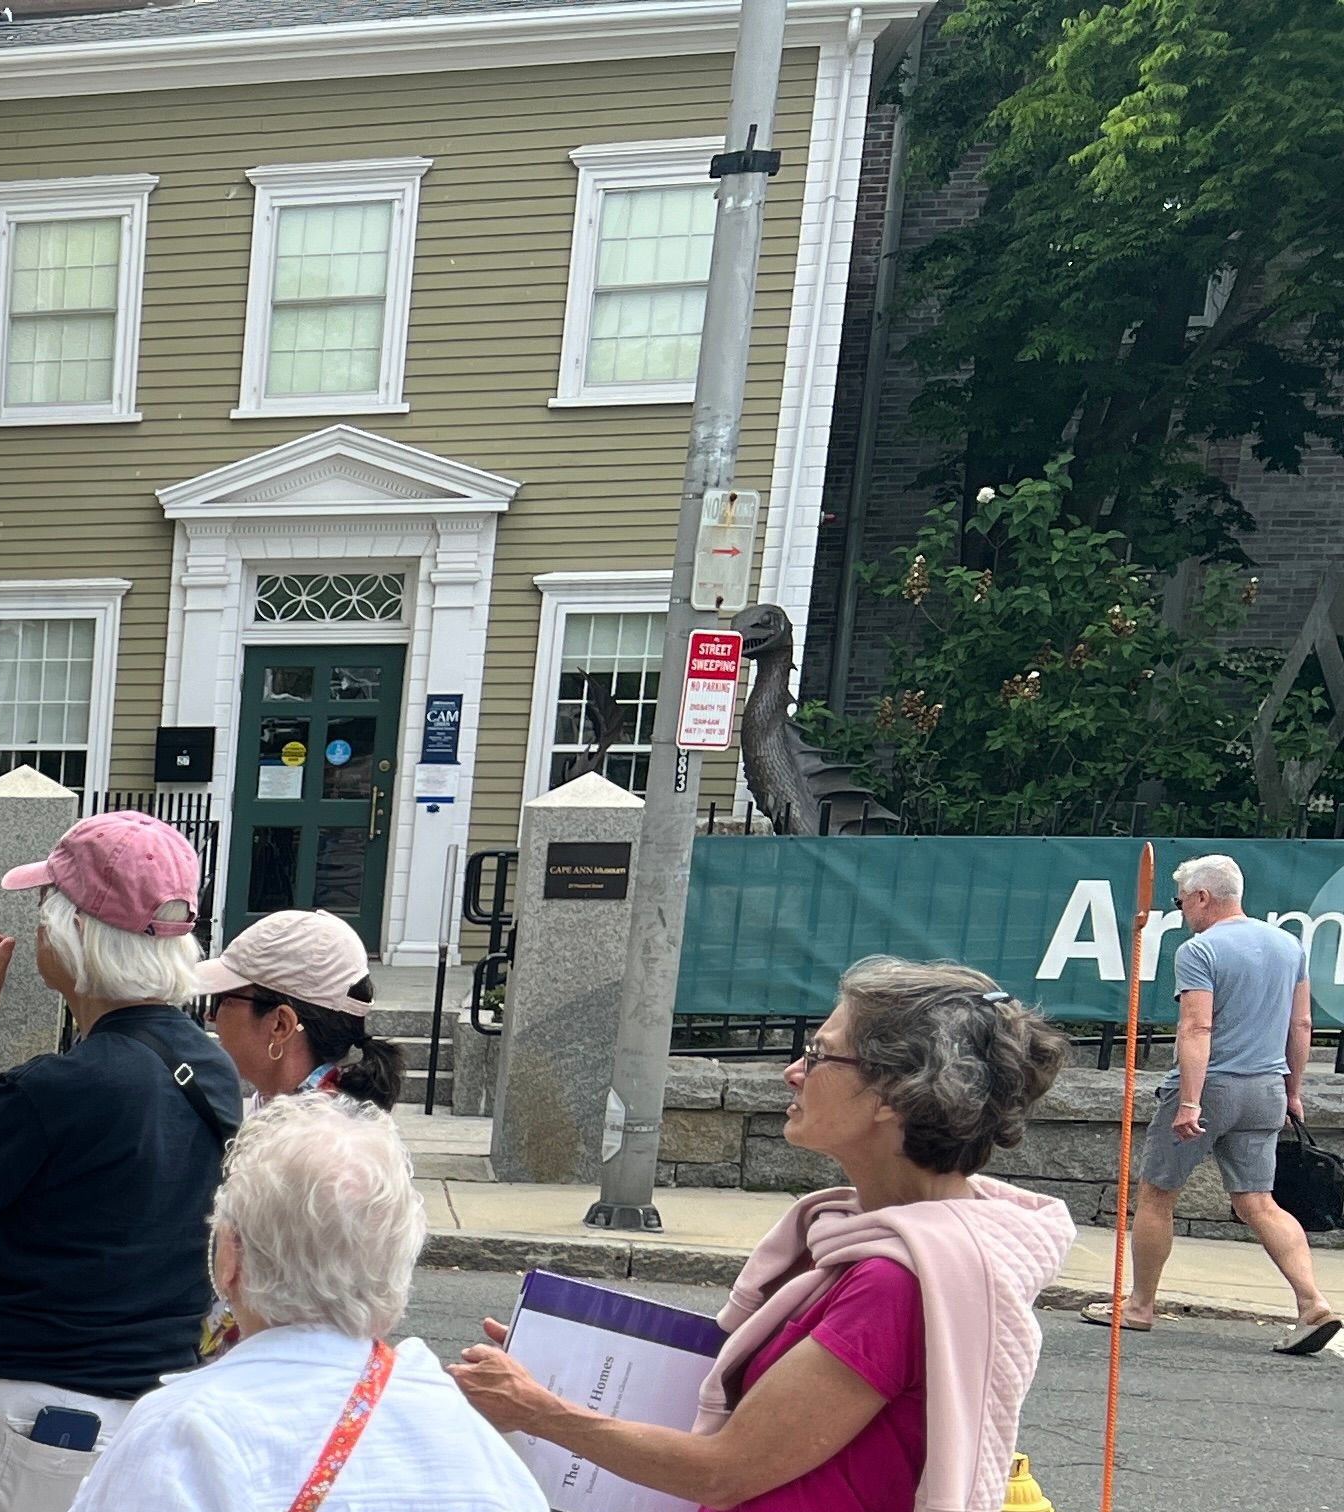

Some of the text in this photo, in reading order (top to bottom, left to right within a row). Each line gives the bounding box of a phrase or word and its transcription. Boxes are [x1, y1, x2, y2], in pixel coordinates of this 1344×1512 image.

[698, 643, 733, 656] STREET
[691, 658, 736, 672] SWEEPING
[690, 680, 731, 693] NO PARKING
[426, 710, 459, 722] CAM
[550, 866, 572, 874] CAPE
[573, 866, 593, 874] ANN
[562, 1462, 581, 1488] The
[589, 1355, 614, 1402] Homes
